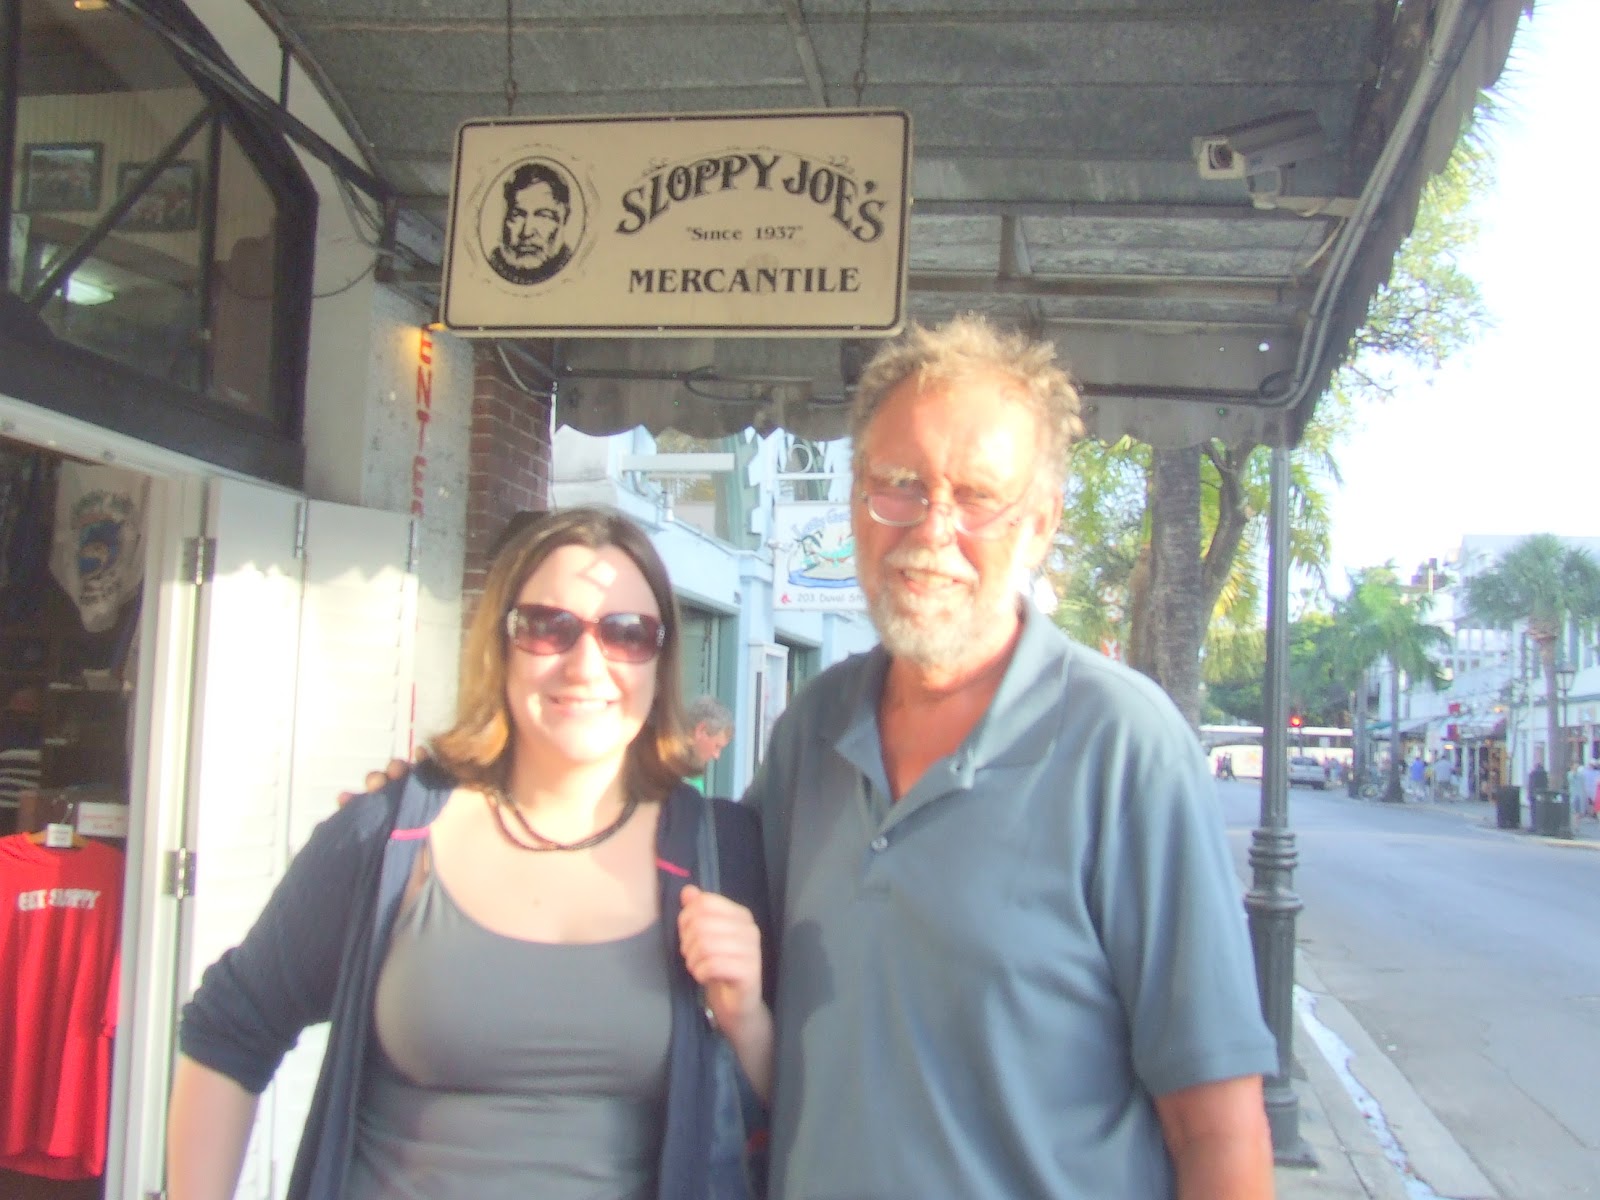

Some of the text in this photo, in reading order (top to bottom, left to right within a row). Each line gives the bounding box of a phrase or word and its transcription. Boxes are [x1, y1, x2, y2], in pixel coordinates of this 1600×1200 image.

[615, 153, 887, 243] SLOPPY JOE'S
[628, 266, 862, 294] MERCANTILE
